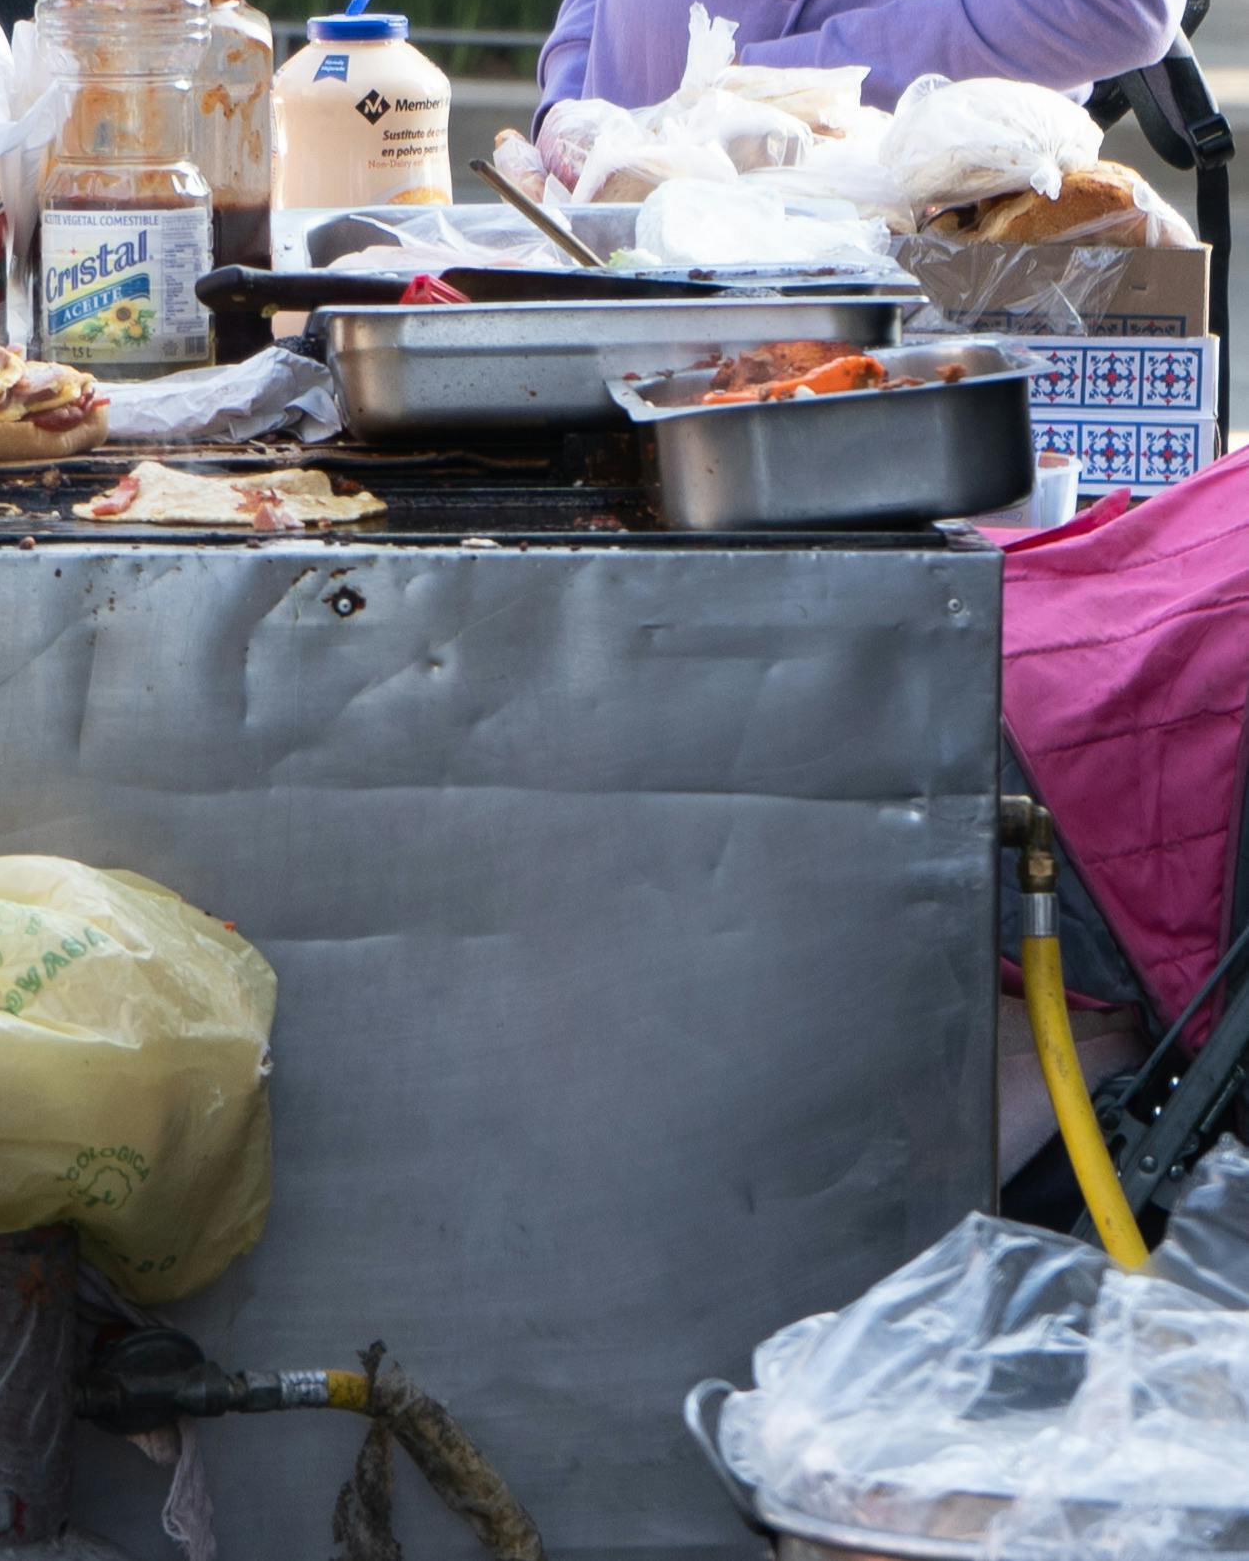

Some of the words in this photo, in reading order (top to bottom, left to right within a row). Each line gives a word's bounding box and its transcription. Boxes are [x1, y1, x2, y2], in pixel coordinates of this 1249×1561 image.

[382, 128, 424, 141] Sustituto
[381, 148, 395, 158] en
[396, 144, 423, 159] polvo
[62, 214, 97, 226] VEGETAL
[100, 214, 158, 226] COMESTIBLE
[45, 229, 148, 304] Cristal
[62, 286, 123, 323] ACEITE
[55, 1145, 151, 1183] COLOGICA
